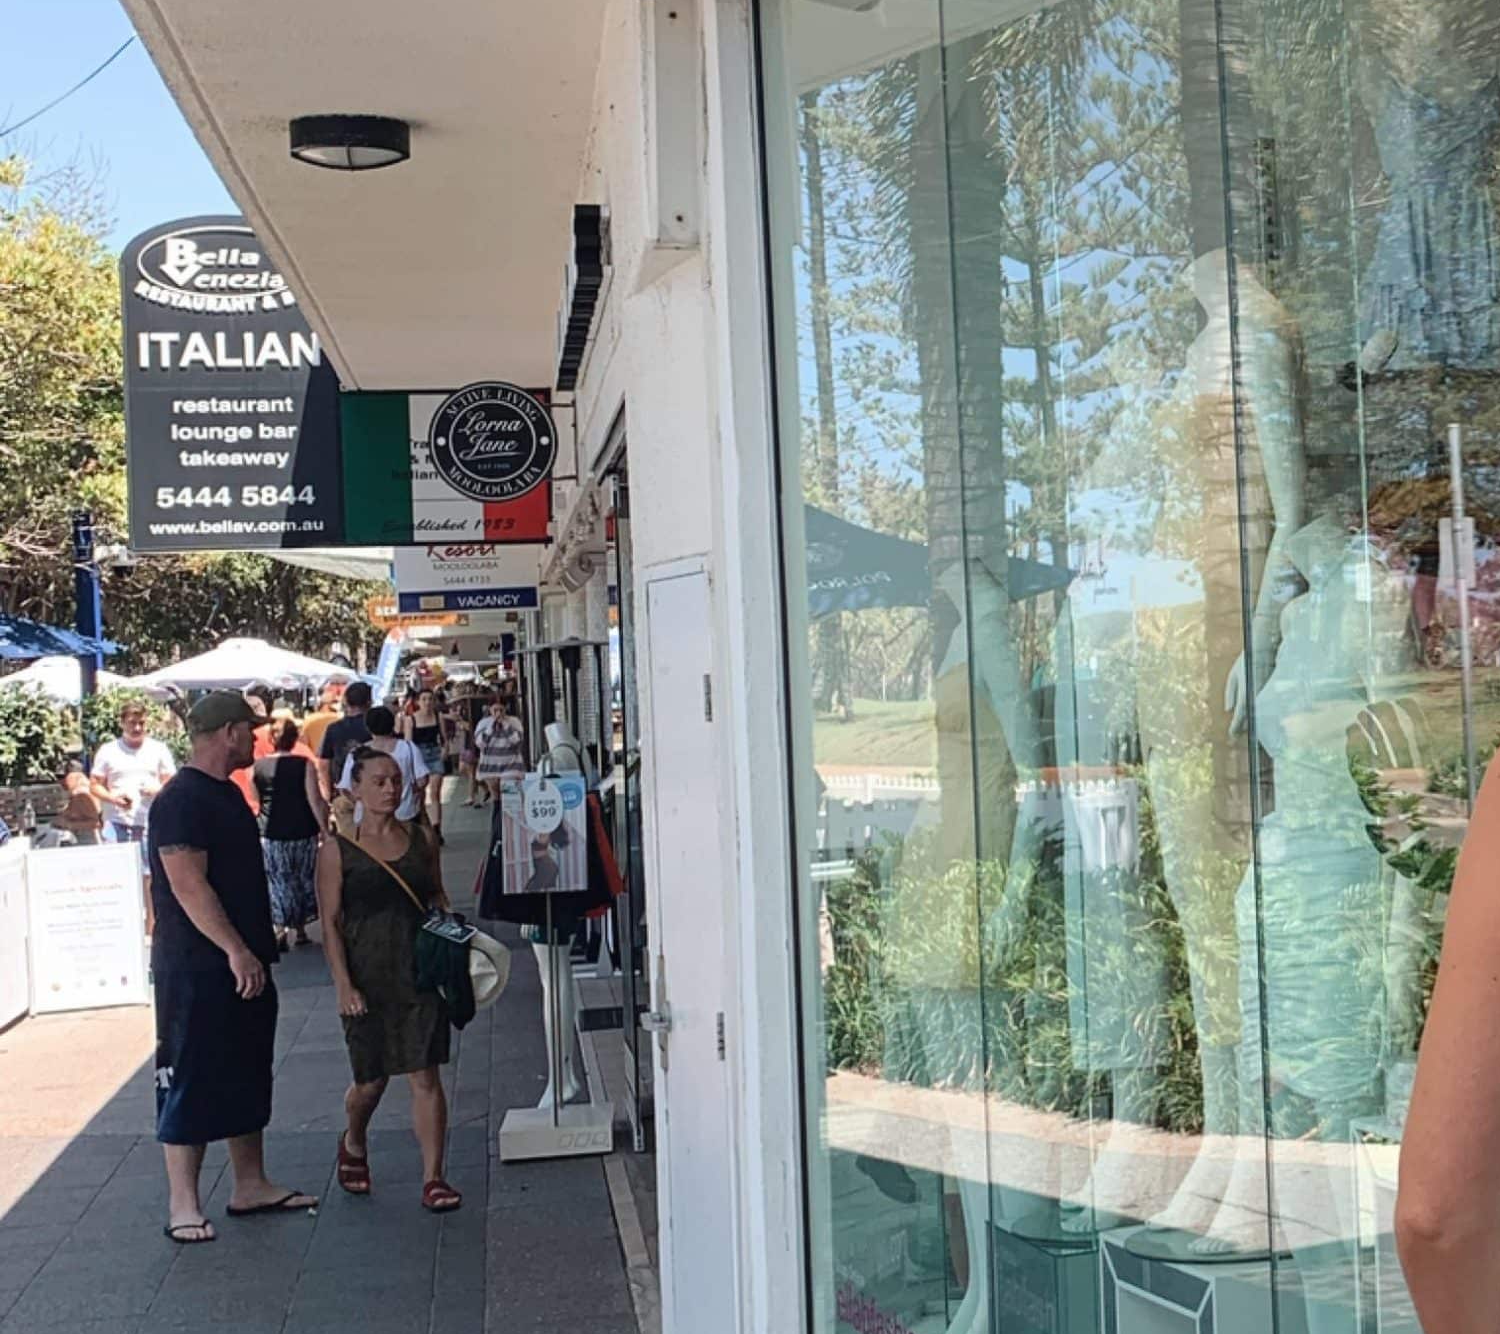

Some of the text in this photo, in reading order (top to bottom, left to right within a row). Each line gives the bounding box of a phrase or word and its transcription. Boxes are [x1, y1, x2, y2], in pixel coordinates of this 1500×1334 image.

[163, 237, 260, 269] Bella
[159, 264, 288, 289] Venezia
[133, 279, 257, 313] RESTAURANT
[137, 331, 323, 370] ITALIAN
[172, 396, 294, 415] restaurant
[171, 422, 298, 444] lounge bar
[457, 410, 525, 436] Lorna
[458, 432, 526, 461] Jane
[179, 450, 290, 469] takeaway
[156, 484, 316, 508] 5444 5844
[149, 519, 324, 536] www.bellav.com.au
[456, 593, 521, 608] VACANCY
[531, 807, 557, 819] $99
